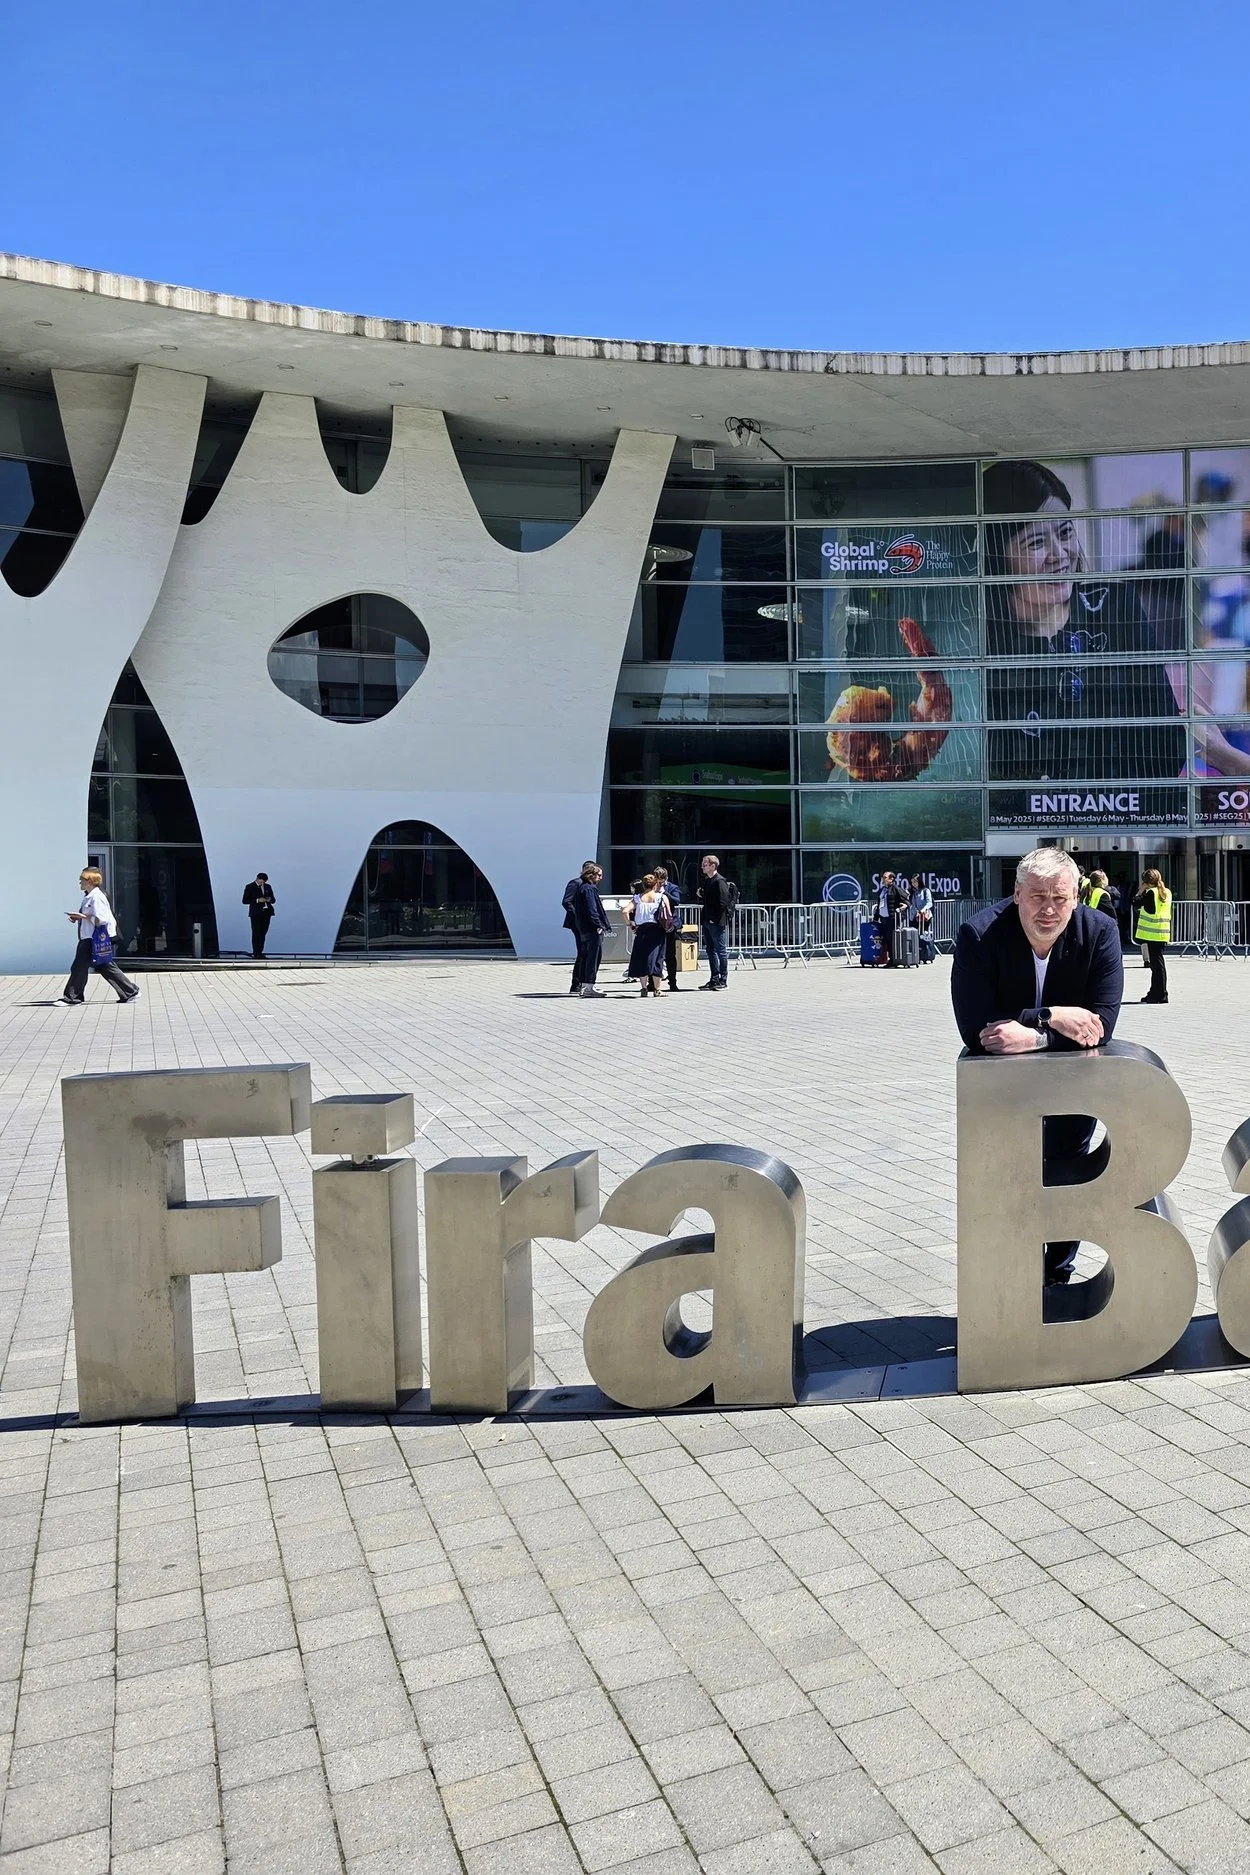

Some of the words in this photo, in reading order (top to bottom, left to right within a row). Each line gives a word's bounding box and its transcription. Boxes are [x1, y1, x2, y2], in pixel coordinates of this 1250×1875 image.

[820, 541, 875, 557] Global
[926, 540, 941, 550] The
[926, 550, 950, 561] Happy
[829, 556, 889, 574] Shrimp
[926, 560, 954, 570] Protein
[1029, 792, 1141, 813] ENTRANCE
[990, 815, 995, 823] 8
[996, 815, 1013, 825] May
[1013, 815, 1033, 823] 2025
[1036, 815, 1066, 823] #SEG25
[1069, 814, 1102, 824] Tuesday
[1102, 814, 1108, 822] 6
[1108, 814, 1125, 823] May
[1130, 813, 1165, 823] Thursday
[1165, 813, 1171, 821] 8
[1172, 813, 1189, 822] May
[1212, 812, 1244, 820] #SEG25
[928, 872, 961, 898] Expo
[62, 1063, 806, 1423] Fira
